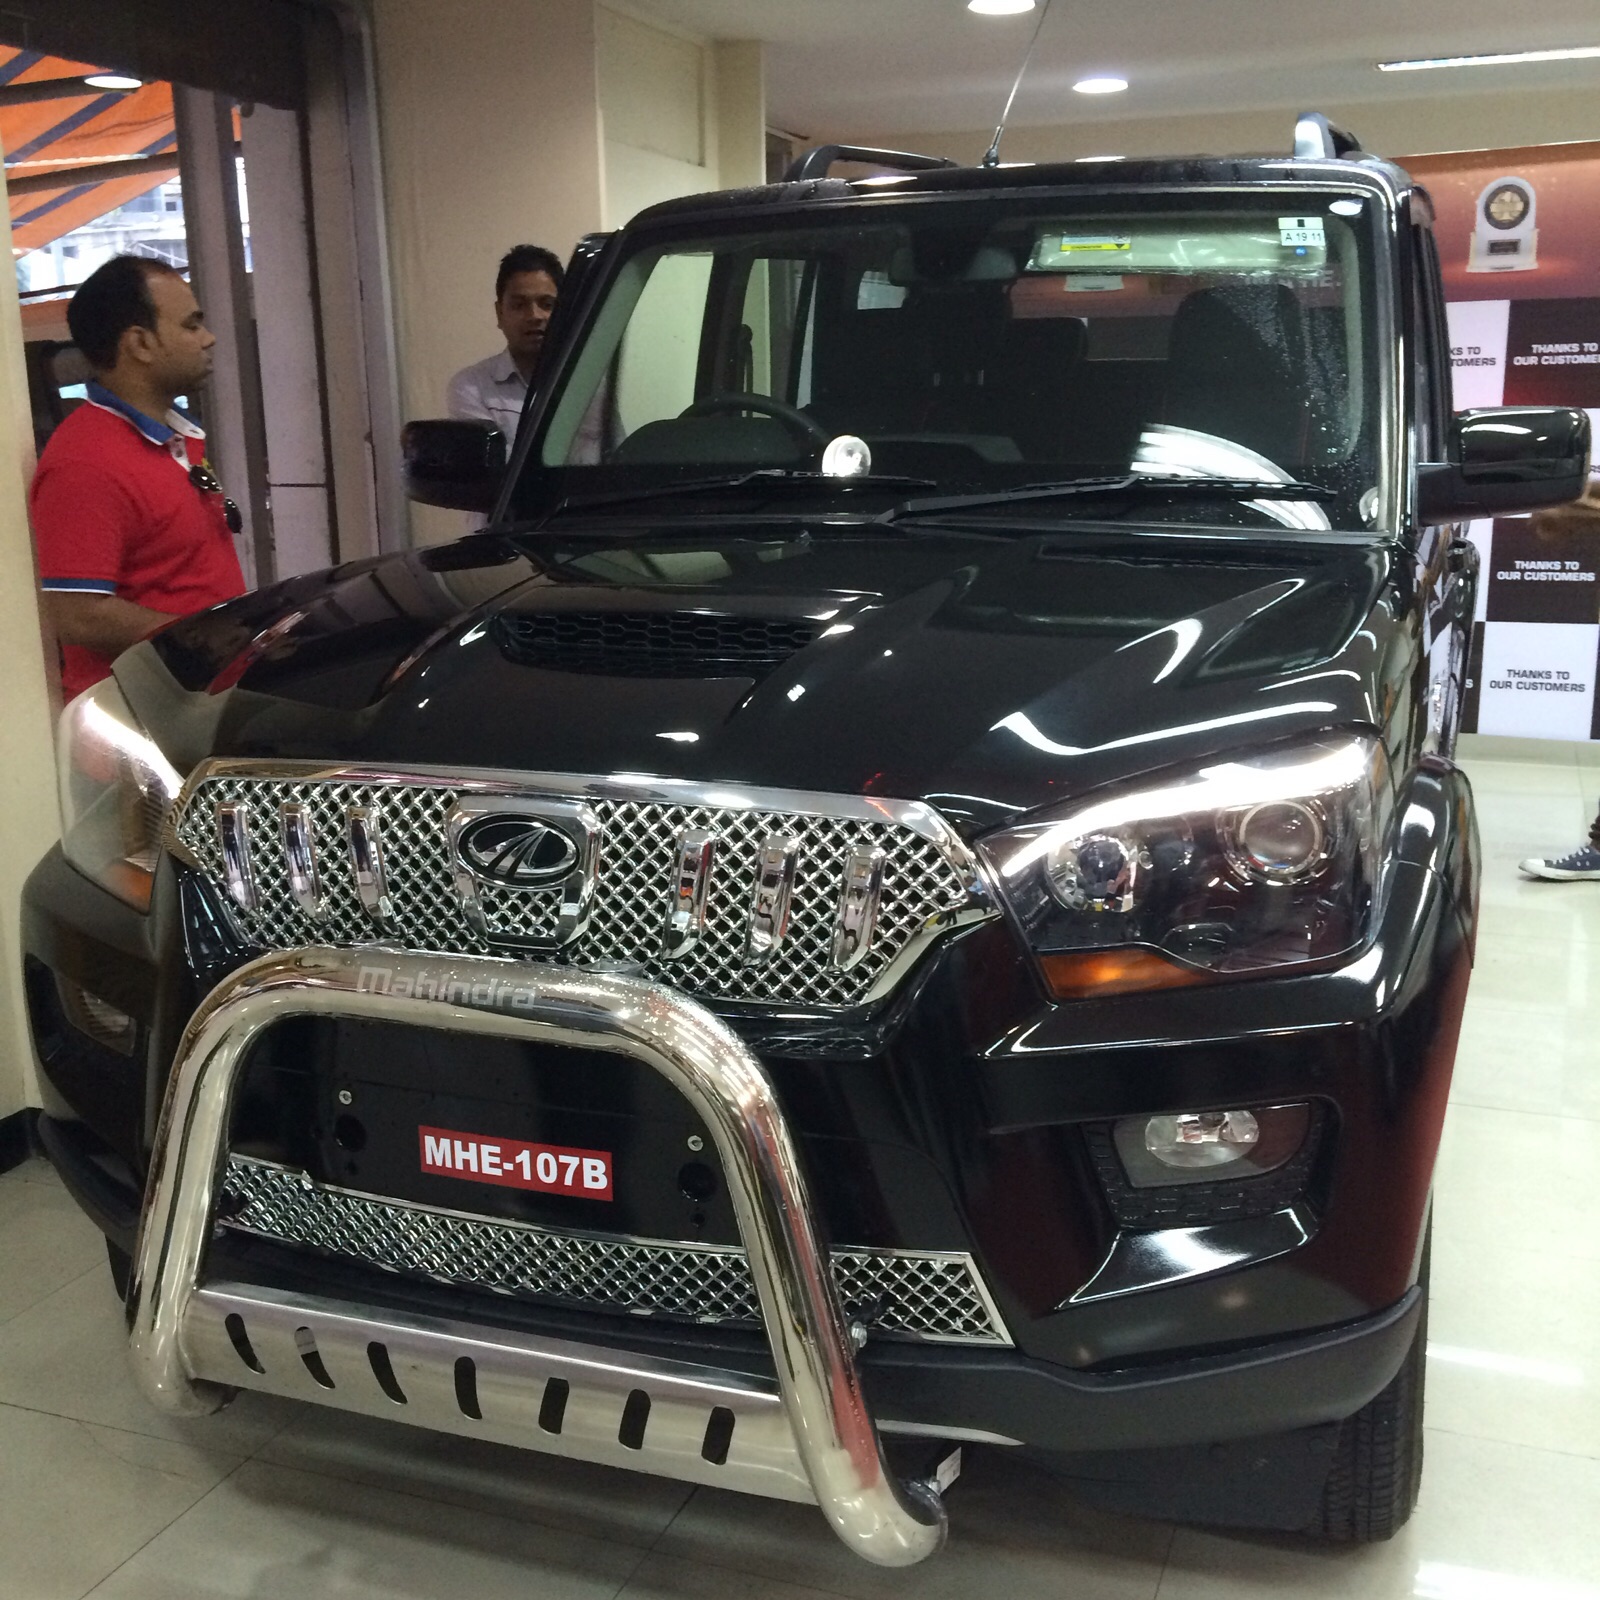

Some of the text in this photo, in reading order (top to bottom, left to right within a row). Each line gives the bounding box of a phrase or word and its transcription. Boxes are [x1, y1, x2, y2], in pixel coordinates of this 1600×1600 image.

[1467, 346, 1481, 355] TO
[1531, 342, 1598, 353] THANKS TO
[1451, 357, 1496, 367] TOMERS
[1513, 354, 1600, 365] OUR CUSTOME
[1514, 560, 1579, 570] THANKS TO
[1496, 571, 1595, 582] OUR CUSTOMERS
[1507, 669, 1570, 680] THANKS TO
[1490, 680, 1585, 692] OUR CUSTOMERS
[357, 966, 536, 1010] Mahindra
[424, 1135, 608, 1189] MHE-107B
